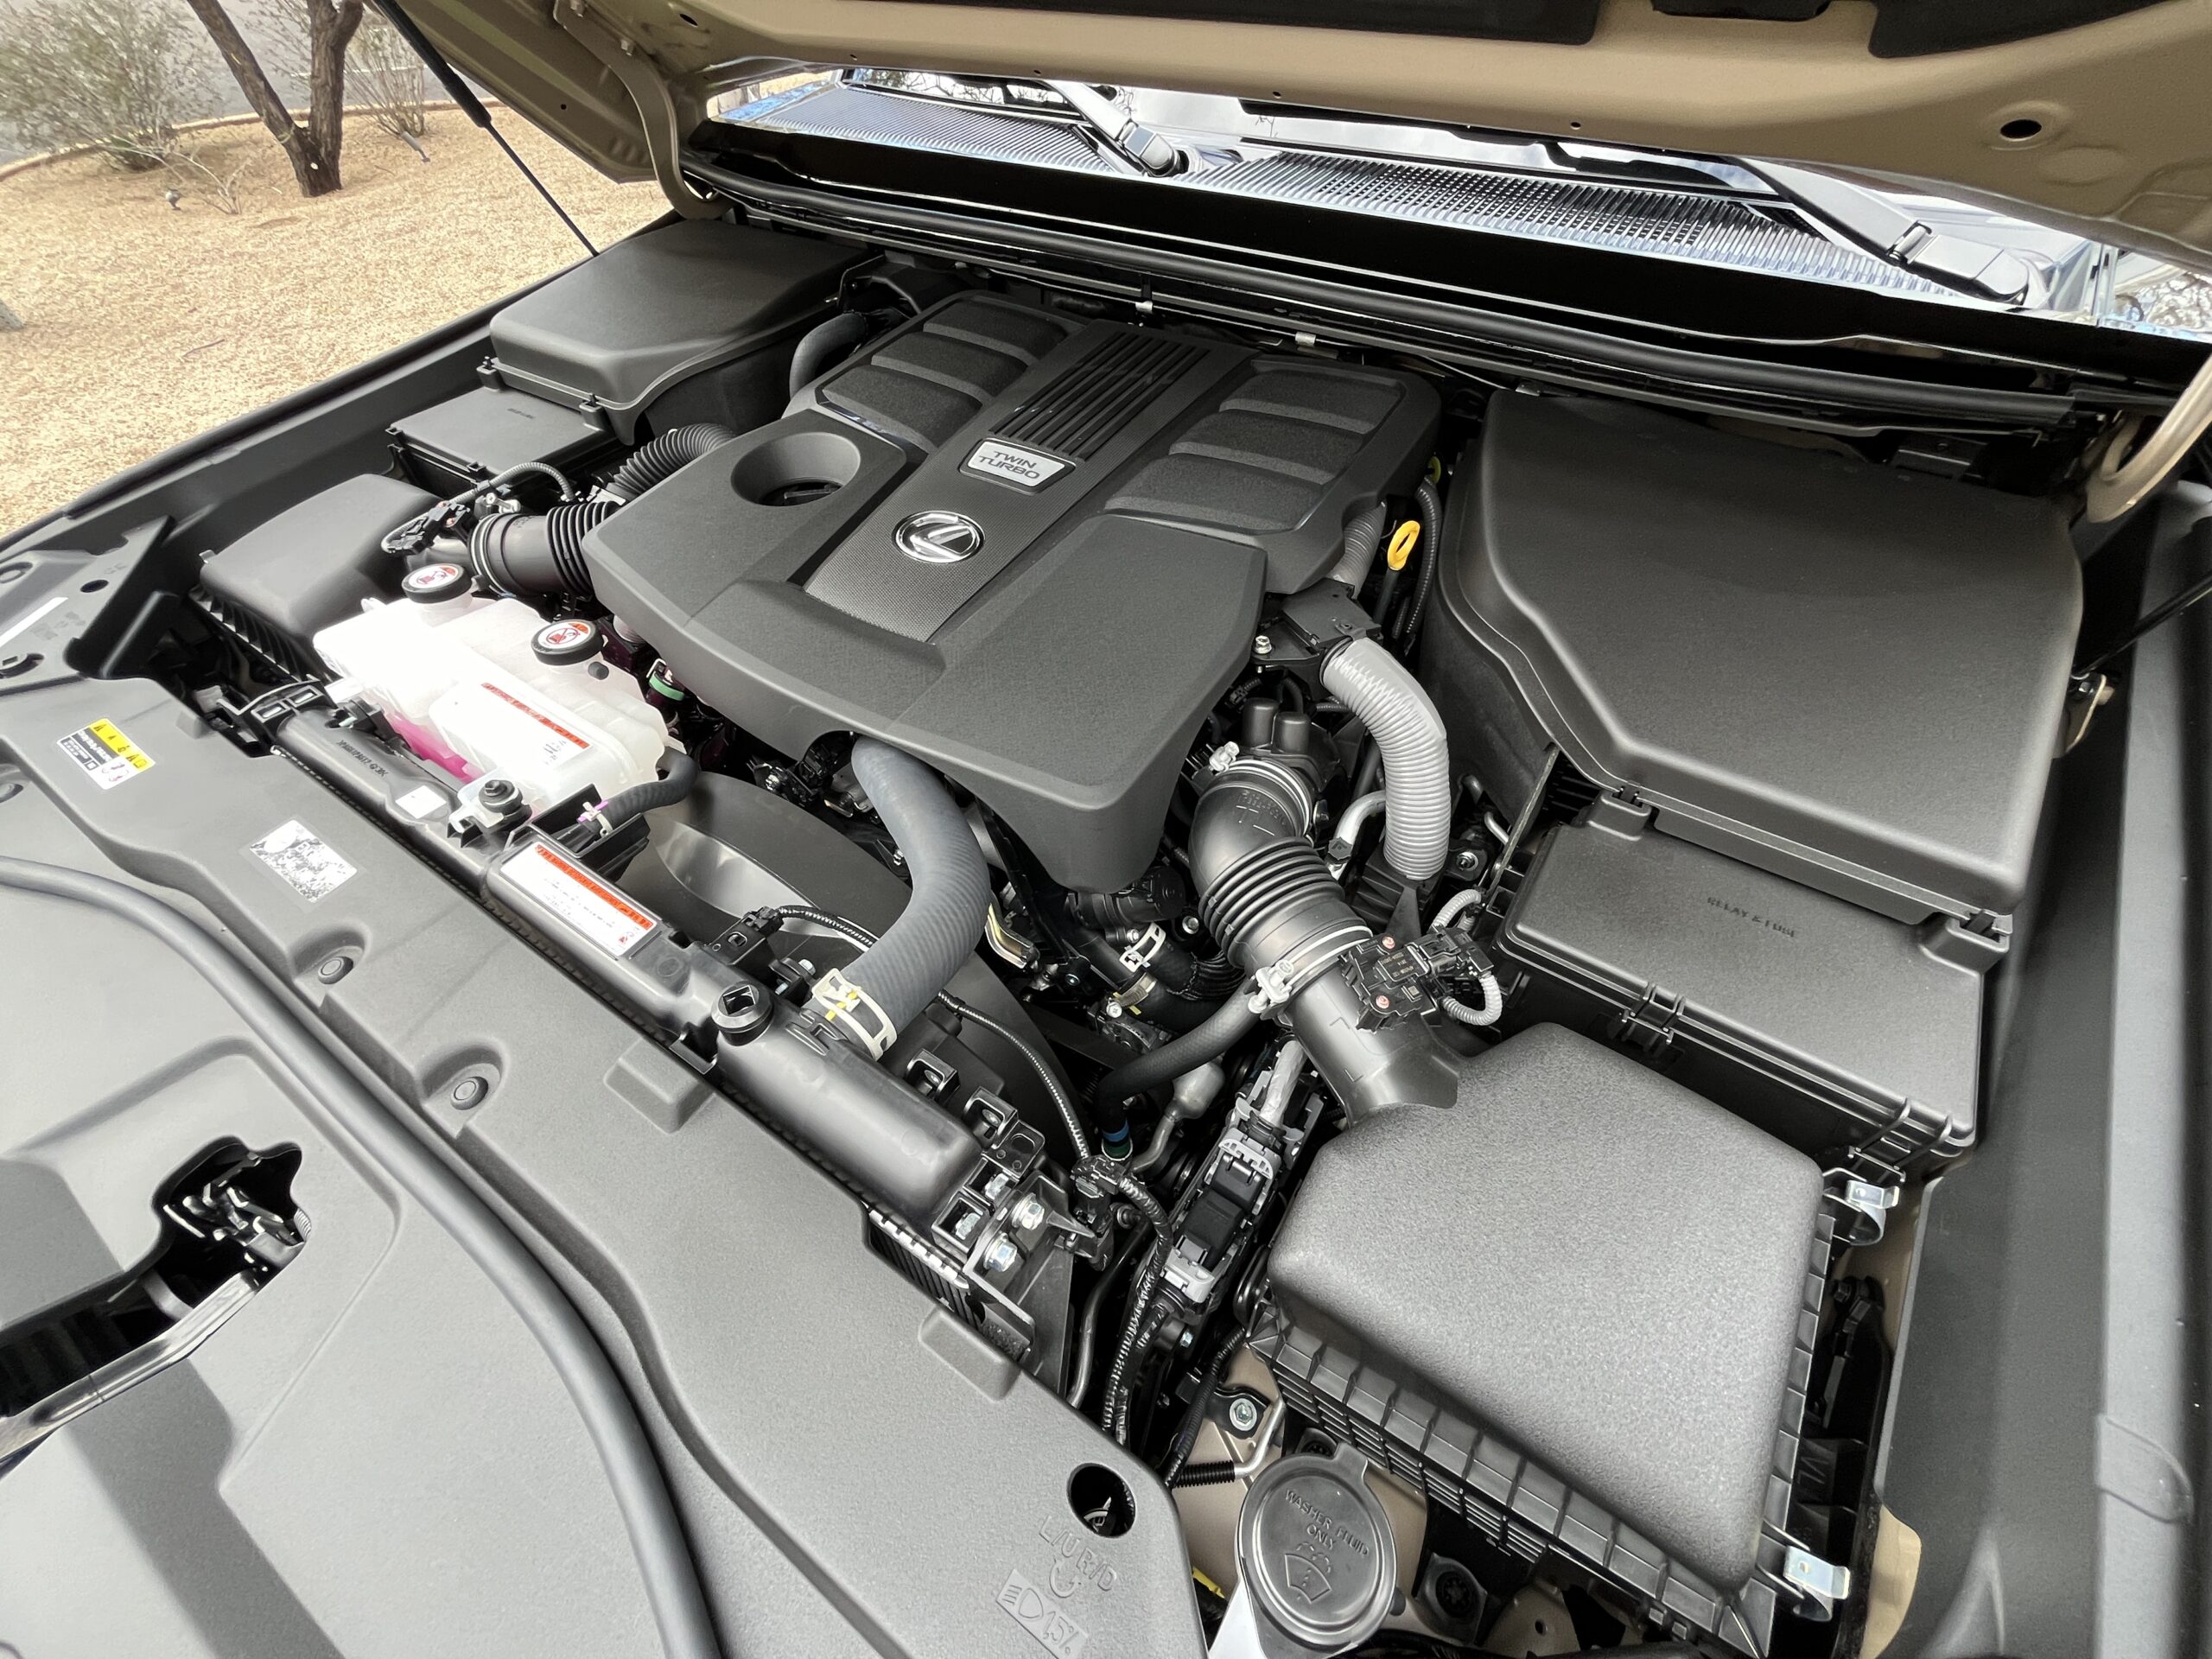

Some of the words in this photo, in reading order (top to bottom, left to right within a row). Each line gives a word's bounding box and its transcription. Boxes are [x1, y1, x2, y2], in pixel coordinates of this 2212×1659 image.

[978, 455, 1040, 480] TURBO
[994, 450, 1037, 469] TWIN
[1285, 1490, 1332, 1530] WASHER
[1336, 1527, 1370, 1555] FLUID
[1306, 1523, 1336, 1550] ONLY
